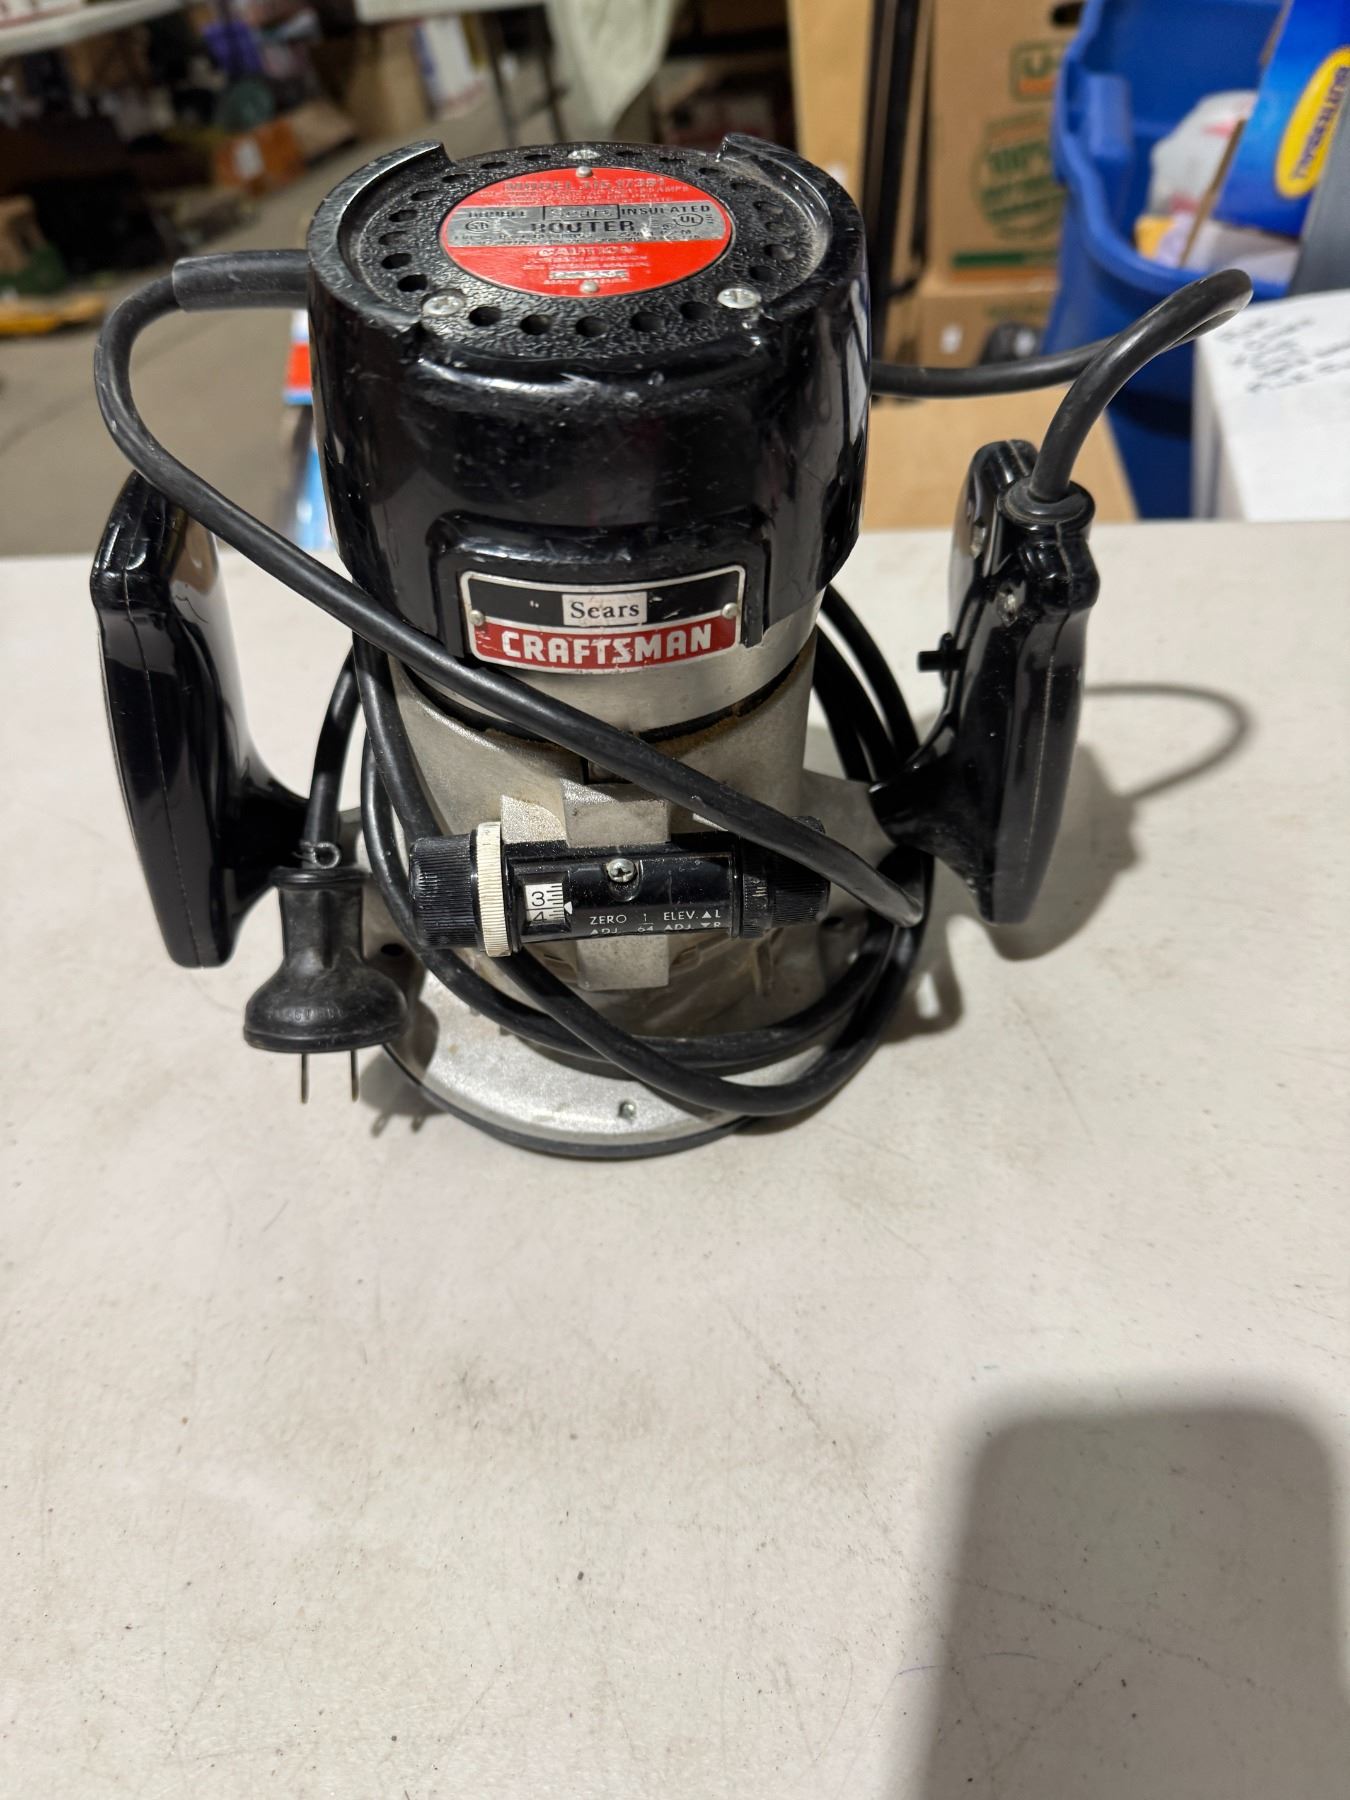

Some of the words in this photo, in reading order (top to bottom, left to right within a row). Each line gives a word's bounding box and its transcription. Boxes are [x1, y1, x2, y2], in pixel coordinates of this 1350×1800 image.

[621, 204, 711, 216] INSULATED
[530, 220, 635, 235] ROUTER
[570, 600, 640, 619] Sears
[501, 623, 712, 664] CRAFTSMAN
[531, 891, 545, 907] 3
[532, 911, 547, 924] 4
[589, 914, 627, 925] ZERO
[663, 910, 699, 921] ELEV.
